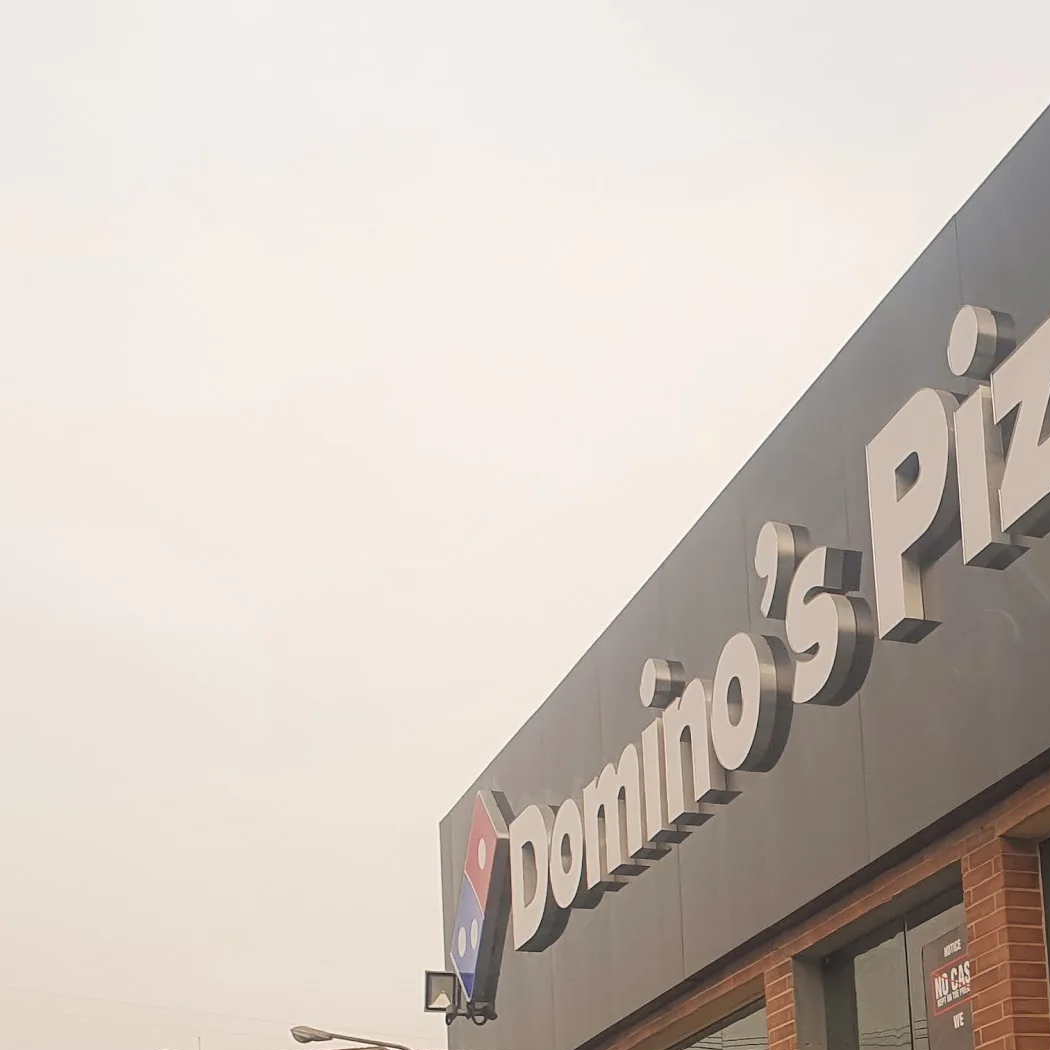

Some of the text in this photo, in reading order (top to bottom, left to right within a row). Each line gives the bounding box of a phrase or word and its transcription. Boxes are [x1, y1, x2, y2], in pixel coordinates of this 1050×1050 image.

[509, 521, 862, 951] Domino's
[934, 972, 949, 999] NO
[953, 1011, 964, 1029] WE
